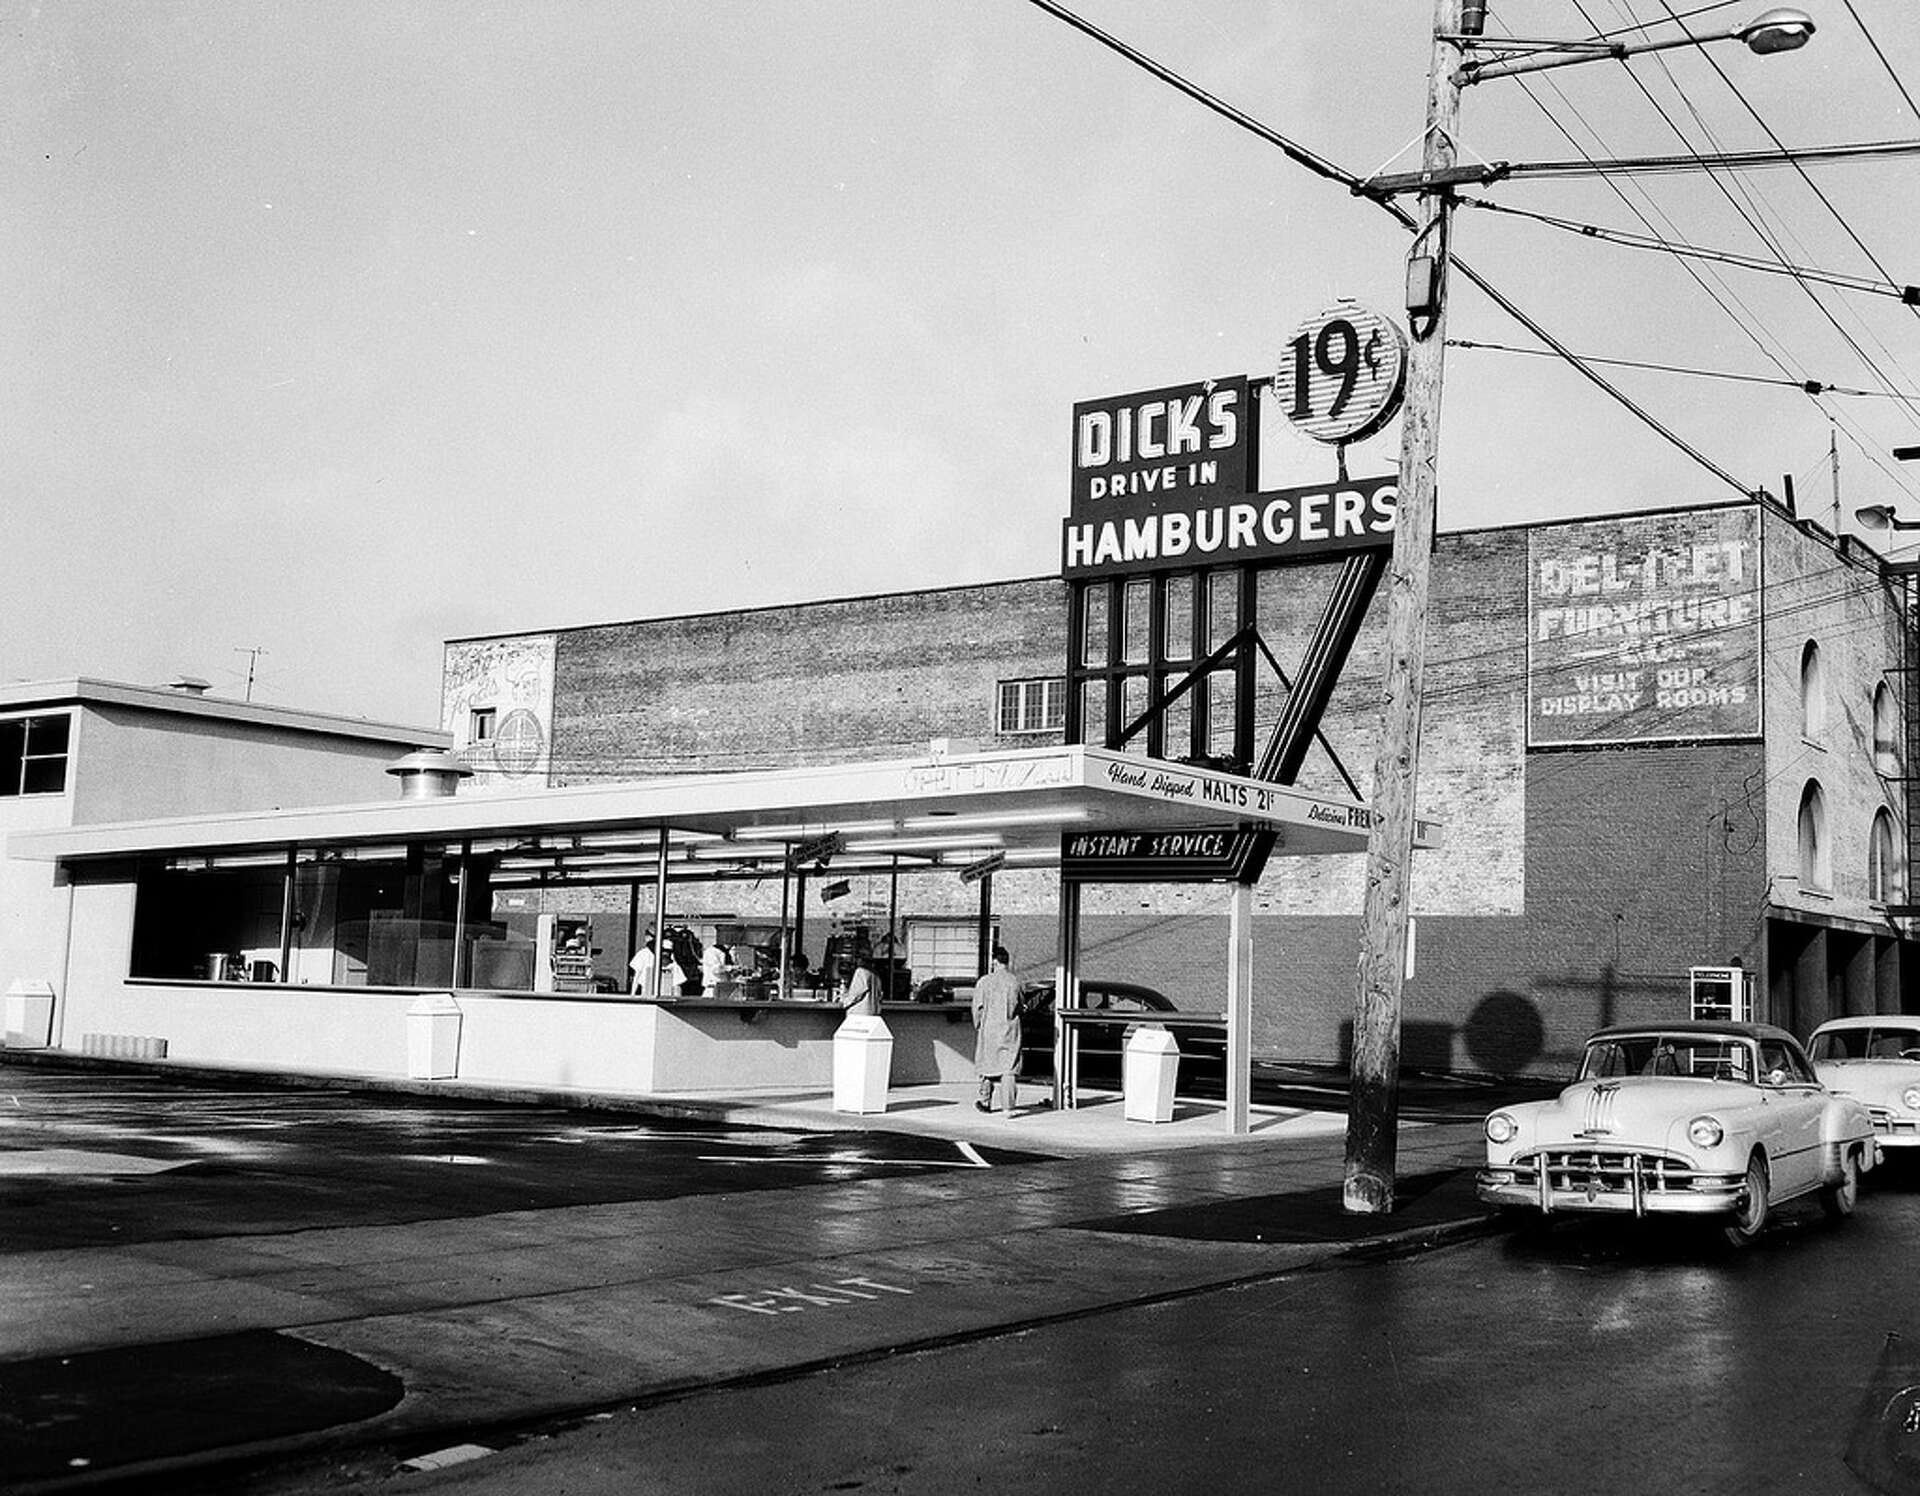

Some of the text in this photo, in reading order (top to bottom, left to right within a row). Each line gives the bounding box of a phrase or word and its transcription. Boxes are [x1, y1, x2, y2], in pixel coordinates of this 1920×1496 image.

[1288, 319, 1380, 419] 19¢
[1090, 460, 1218, 500] DRIVE IN
[1066, 485, 1398, 567] HAMBURGERS
[1574, 667, 1710, 694] VISIT OUR
[1541, 686, 1747, 716] DISPLAY ROOMS
[1108, 762, 1147, 788] Hand
[1150, 773, 1195, 798] Dipped
[1203, 779, 1247, 806] MALTS
[1070, 834, 1224, 856] INSTANT SERVICE
[708, 1276, 913, 1315] EXIT
